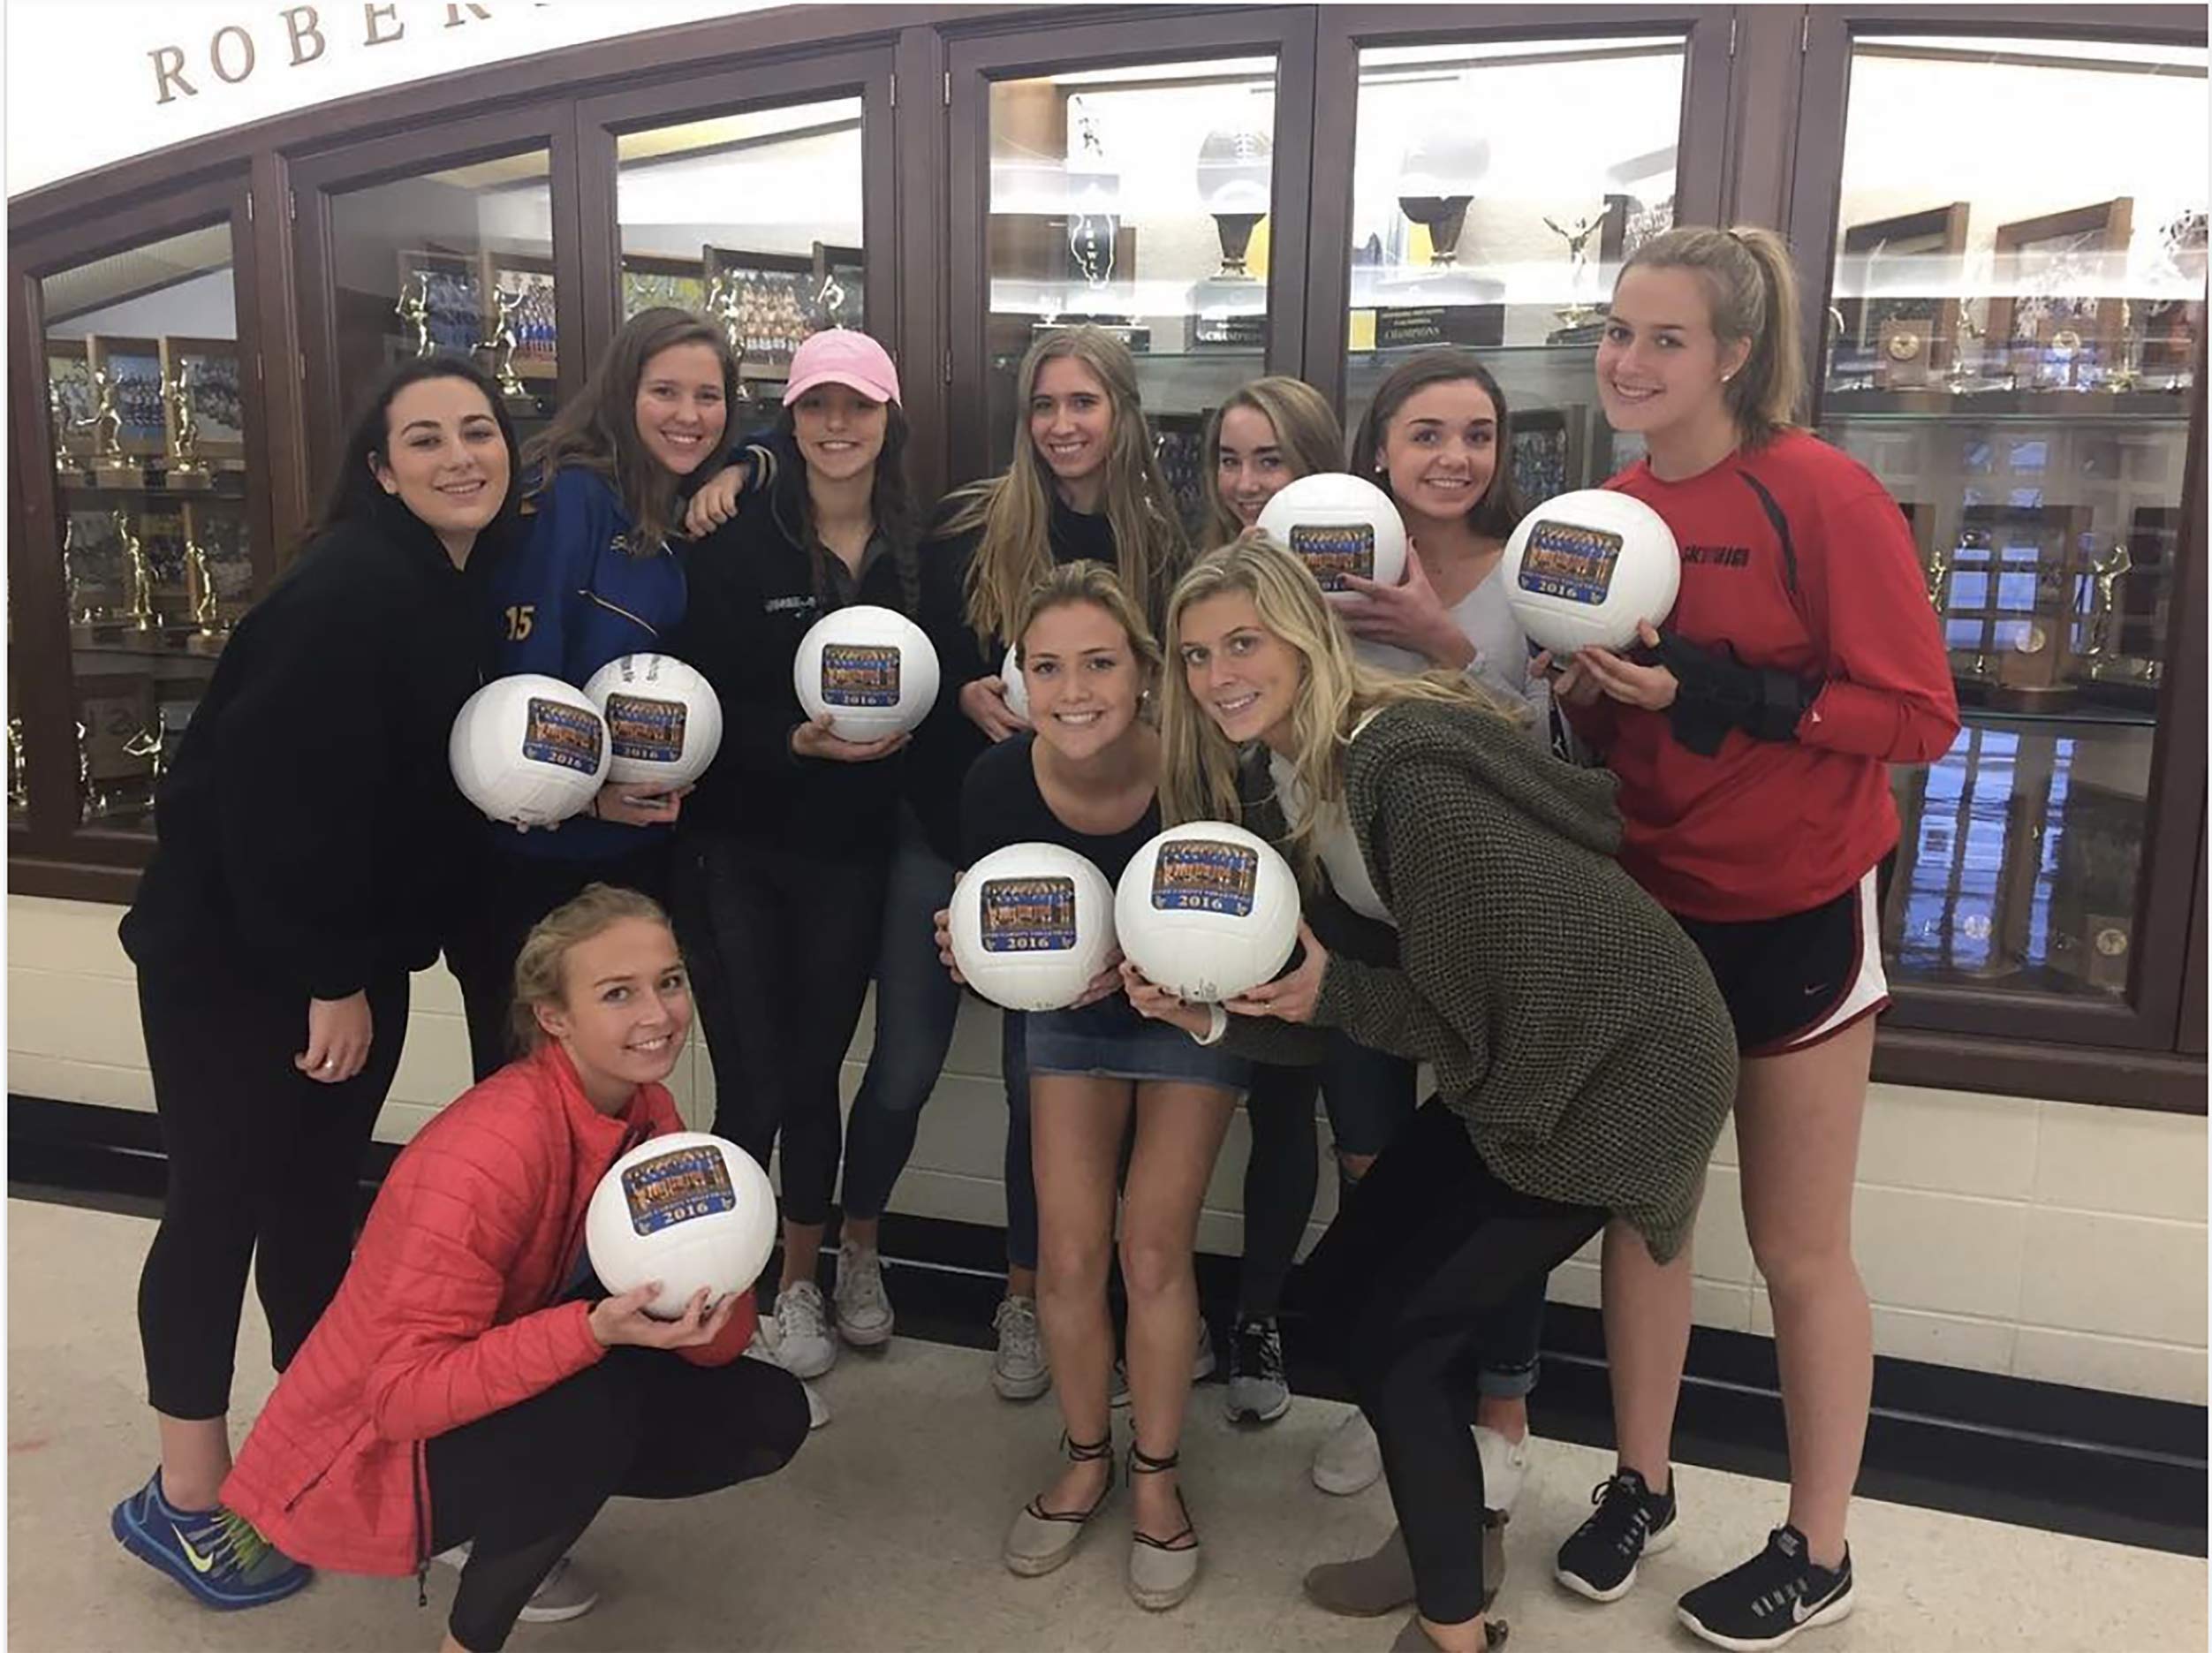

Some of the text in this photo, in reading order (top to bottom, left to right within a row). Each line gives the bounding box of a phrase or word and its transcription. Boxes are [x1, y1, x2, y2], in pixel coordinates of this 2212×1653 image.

[147, 4, 549, 104] ROBE
[1539, 580, 1578, 597] 2016
[505, 606, 535, 641] 15
[844, 694, 877, 705] 2016
[548, 752, 582, 769] 2016
[1178, 895, 1223, 910] 2016
[1007, 936, 1049, 949] 2016
[663, 1202, 708, 1224] 2016
